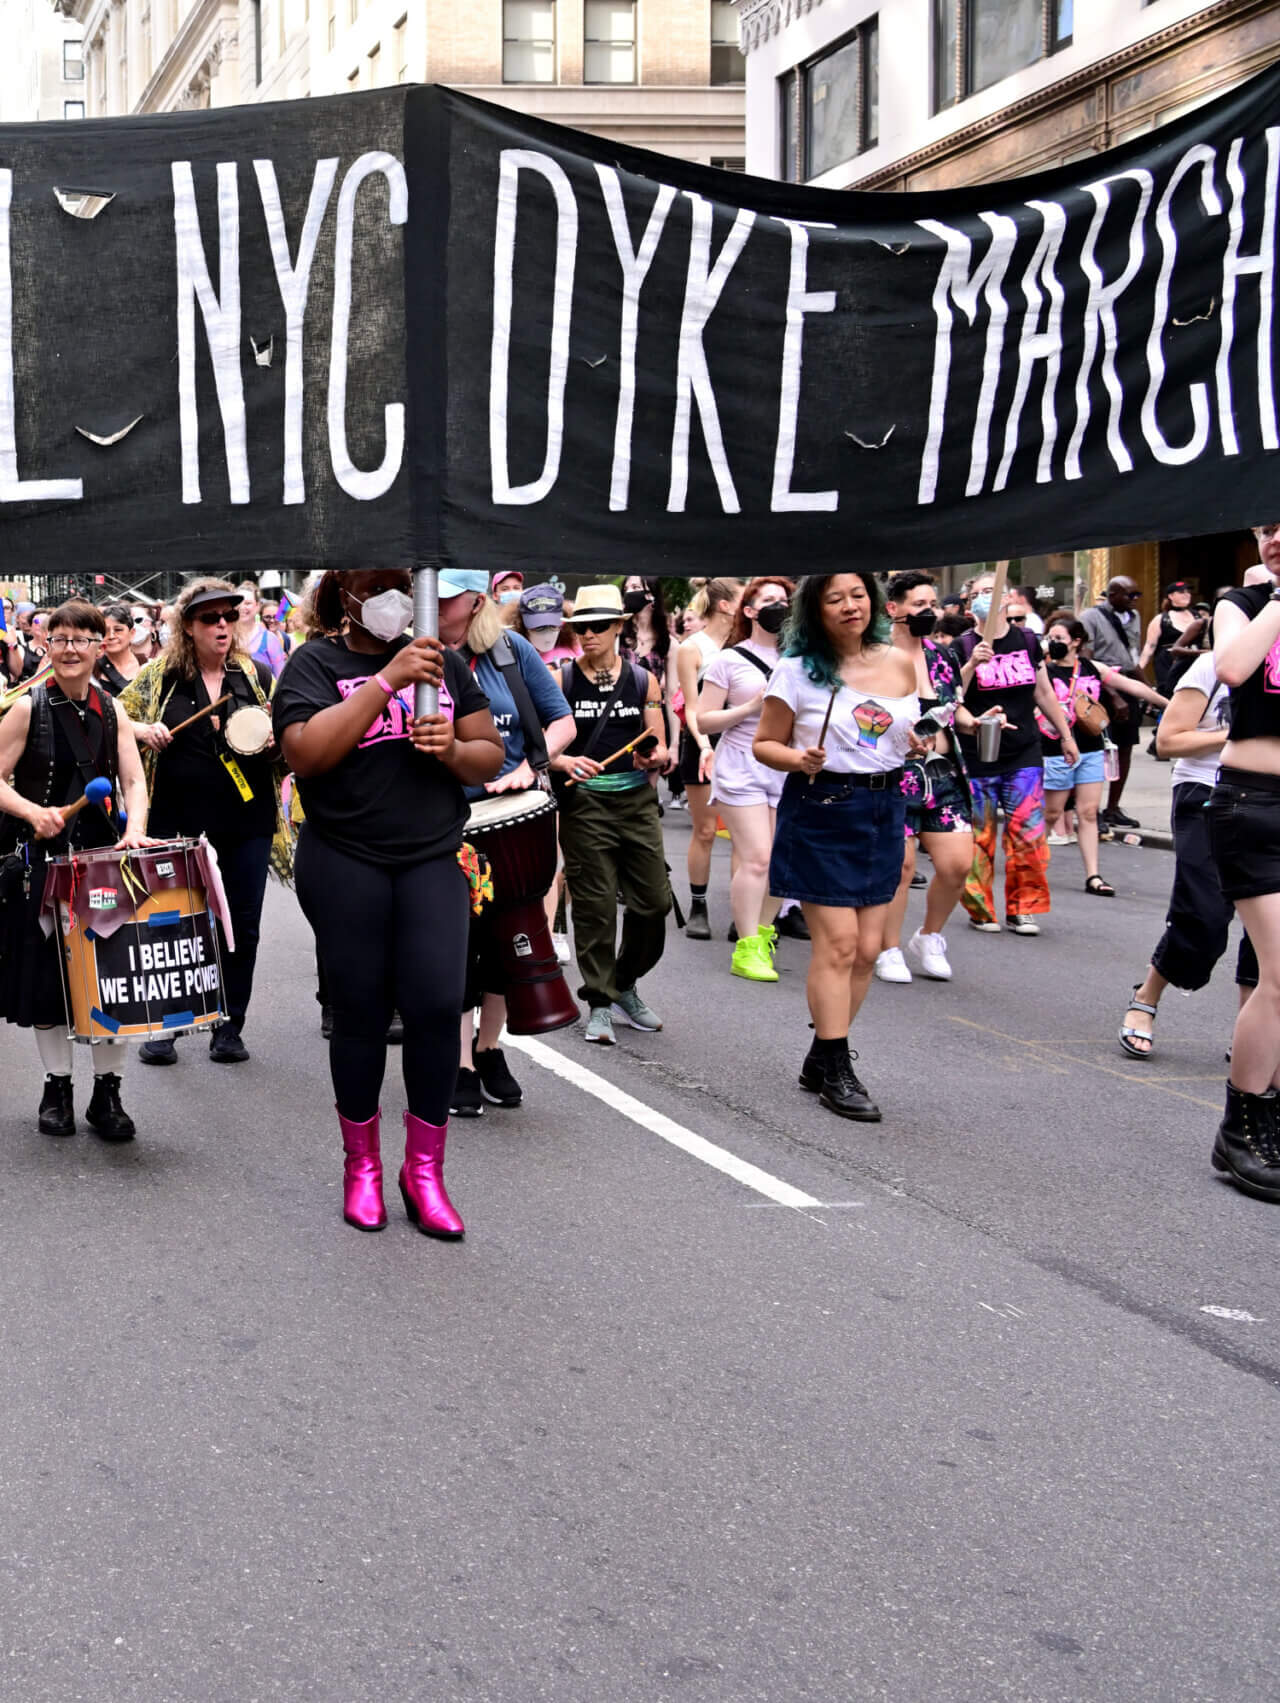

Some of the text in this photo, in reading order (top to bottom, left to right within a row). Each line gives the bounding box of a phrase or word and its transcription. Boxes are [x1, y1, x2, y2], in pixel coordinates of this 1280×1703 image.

[171, 151, 408, 504] NYC
[490, 149, 838, 513] DYKE
[916, 126, 1280, 504] MARCH
[129, 936, 205, 971] I BELIEVE
[101, 977, 129, 1004] WE
[133, 971, 181, 1002] HAVE
